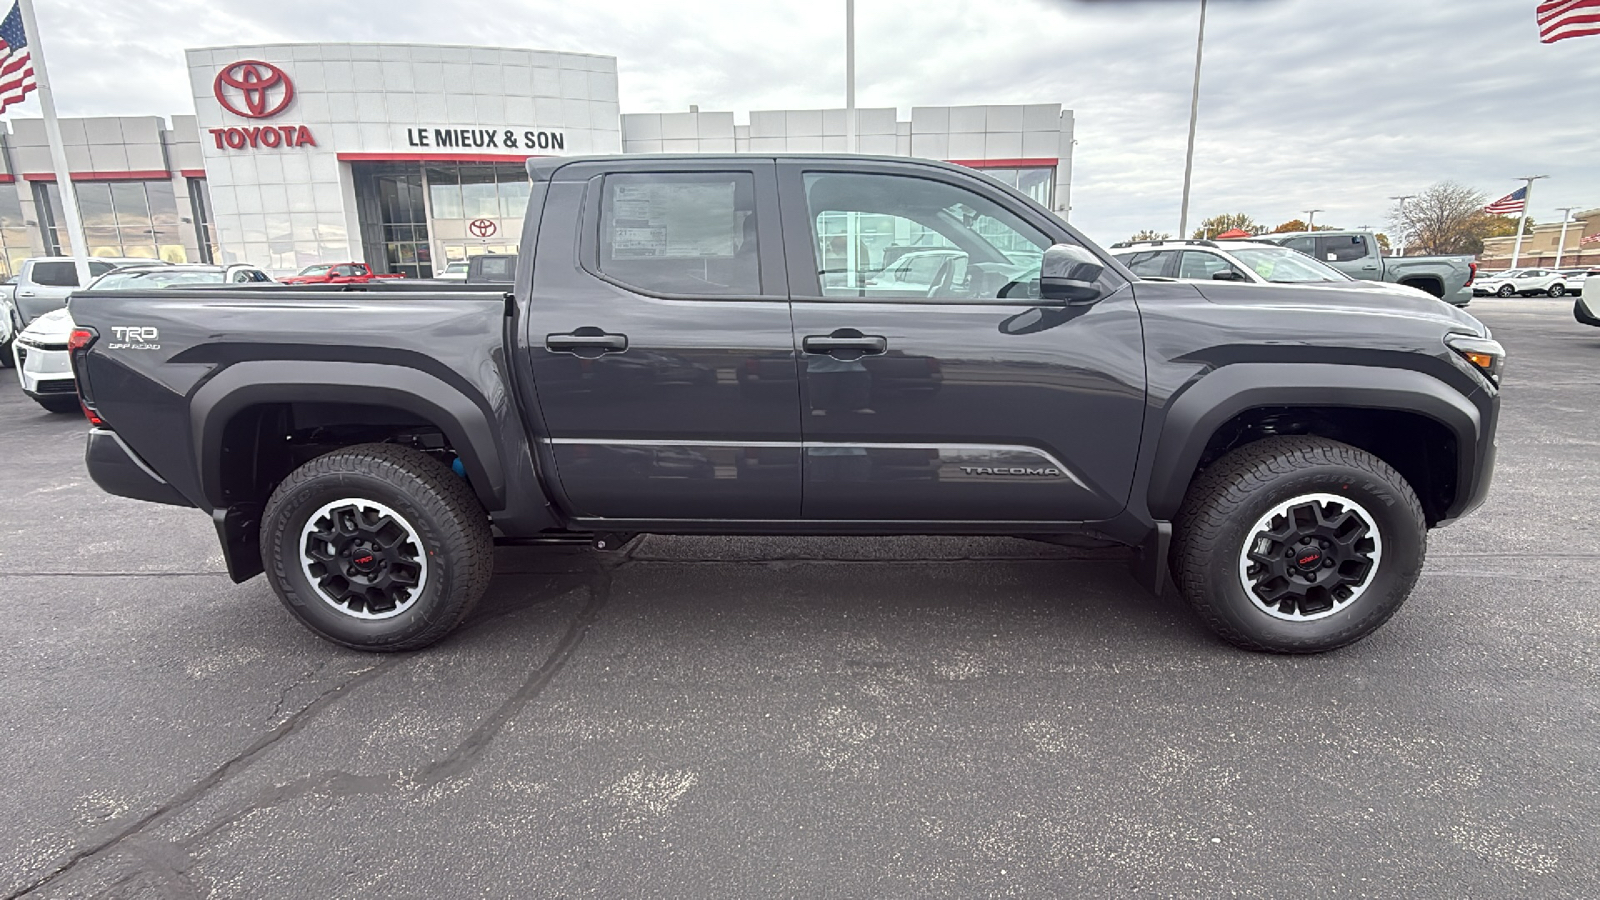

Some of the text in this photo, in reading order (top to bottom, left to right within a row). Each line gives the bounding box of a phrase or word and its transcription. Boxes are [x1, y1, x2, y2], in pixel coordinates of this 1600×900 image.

[209, 125, 317, 149] TOYOTA
[407, 128, 565, 150] LE MIEUX & SON
[111, 326, 159, 343] TRD
[960, 466, 1060, 477] TACOMA
